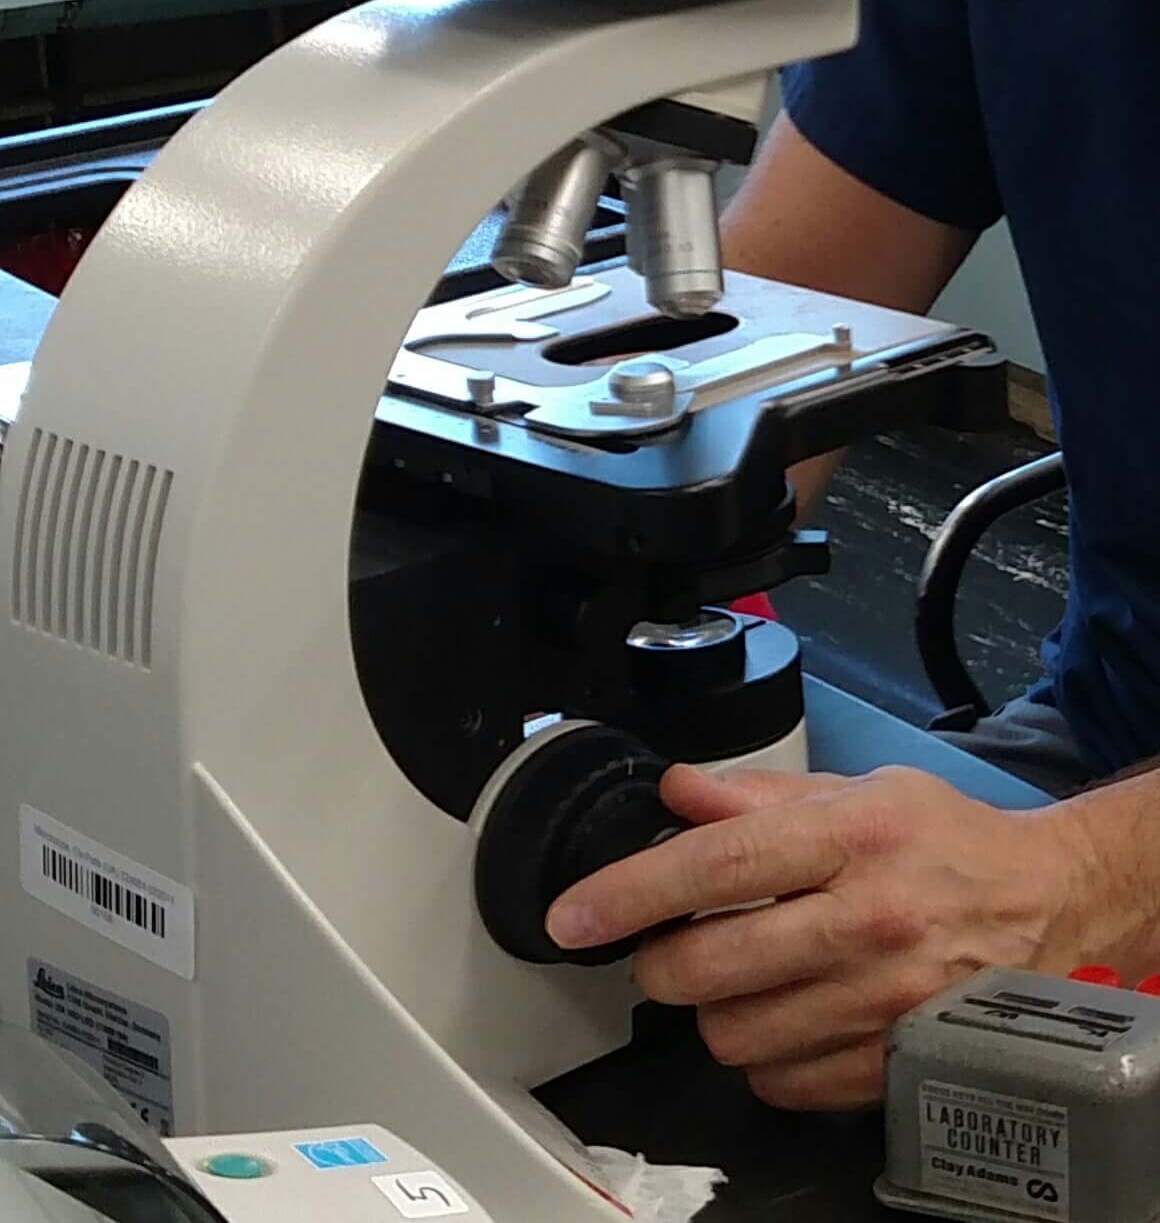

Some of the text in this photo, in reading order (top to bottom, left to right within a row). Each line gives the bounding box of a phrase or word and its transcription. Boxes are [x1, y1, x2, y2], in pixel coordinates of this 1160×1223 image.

[926, 1102, 1061, 1149] LABORATORY
[947, 1129, 1041, 1166] COUNTER
[931, 1156, 1018, 1186] Clay Adams
